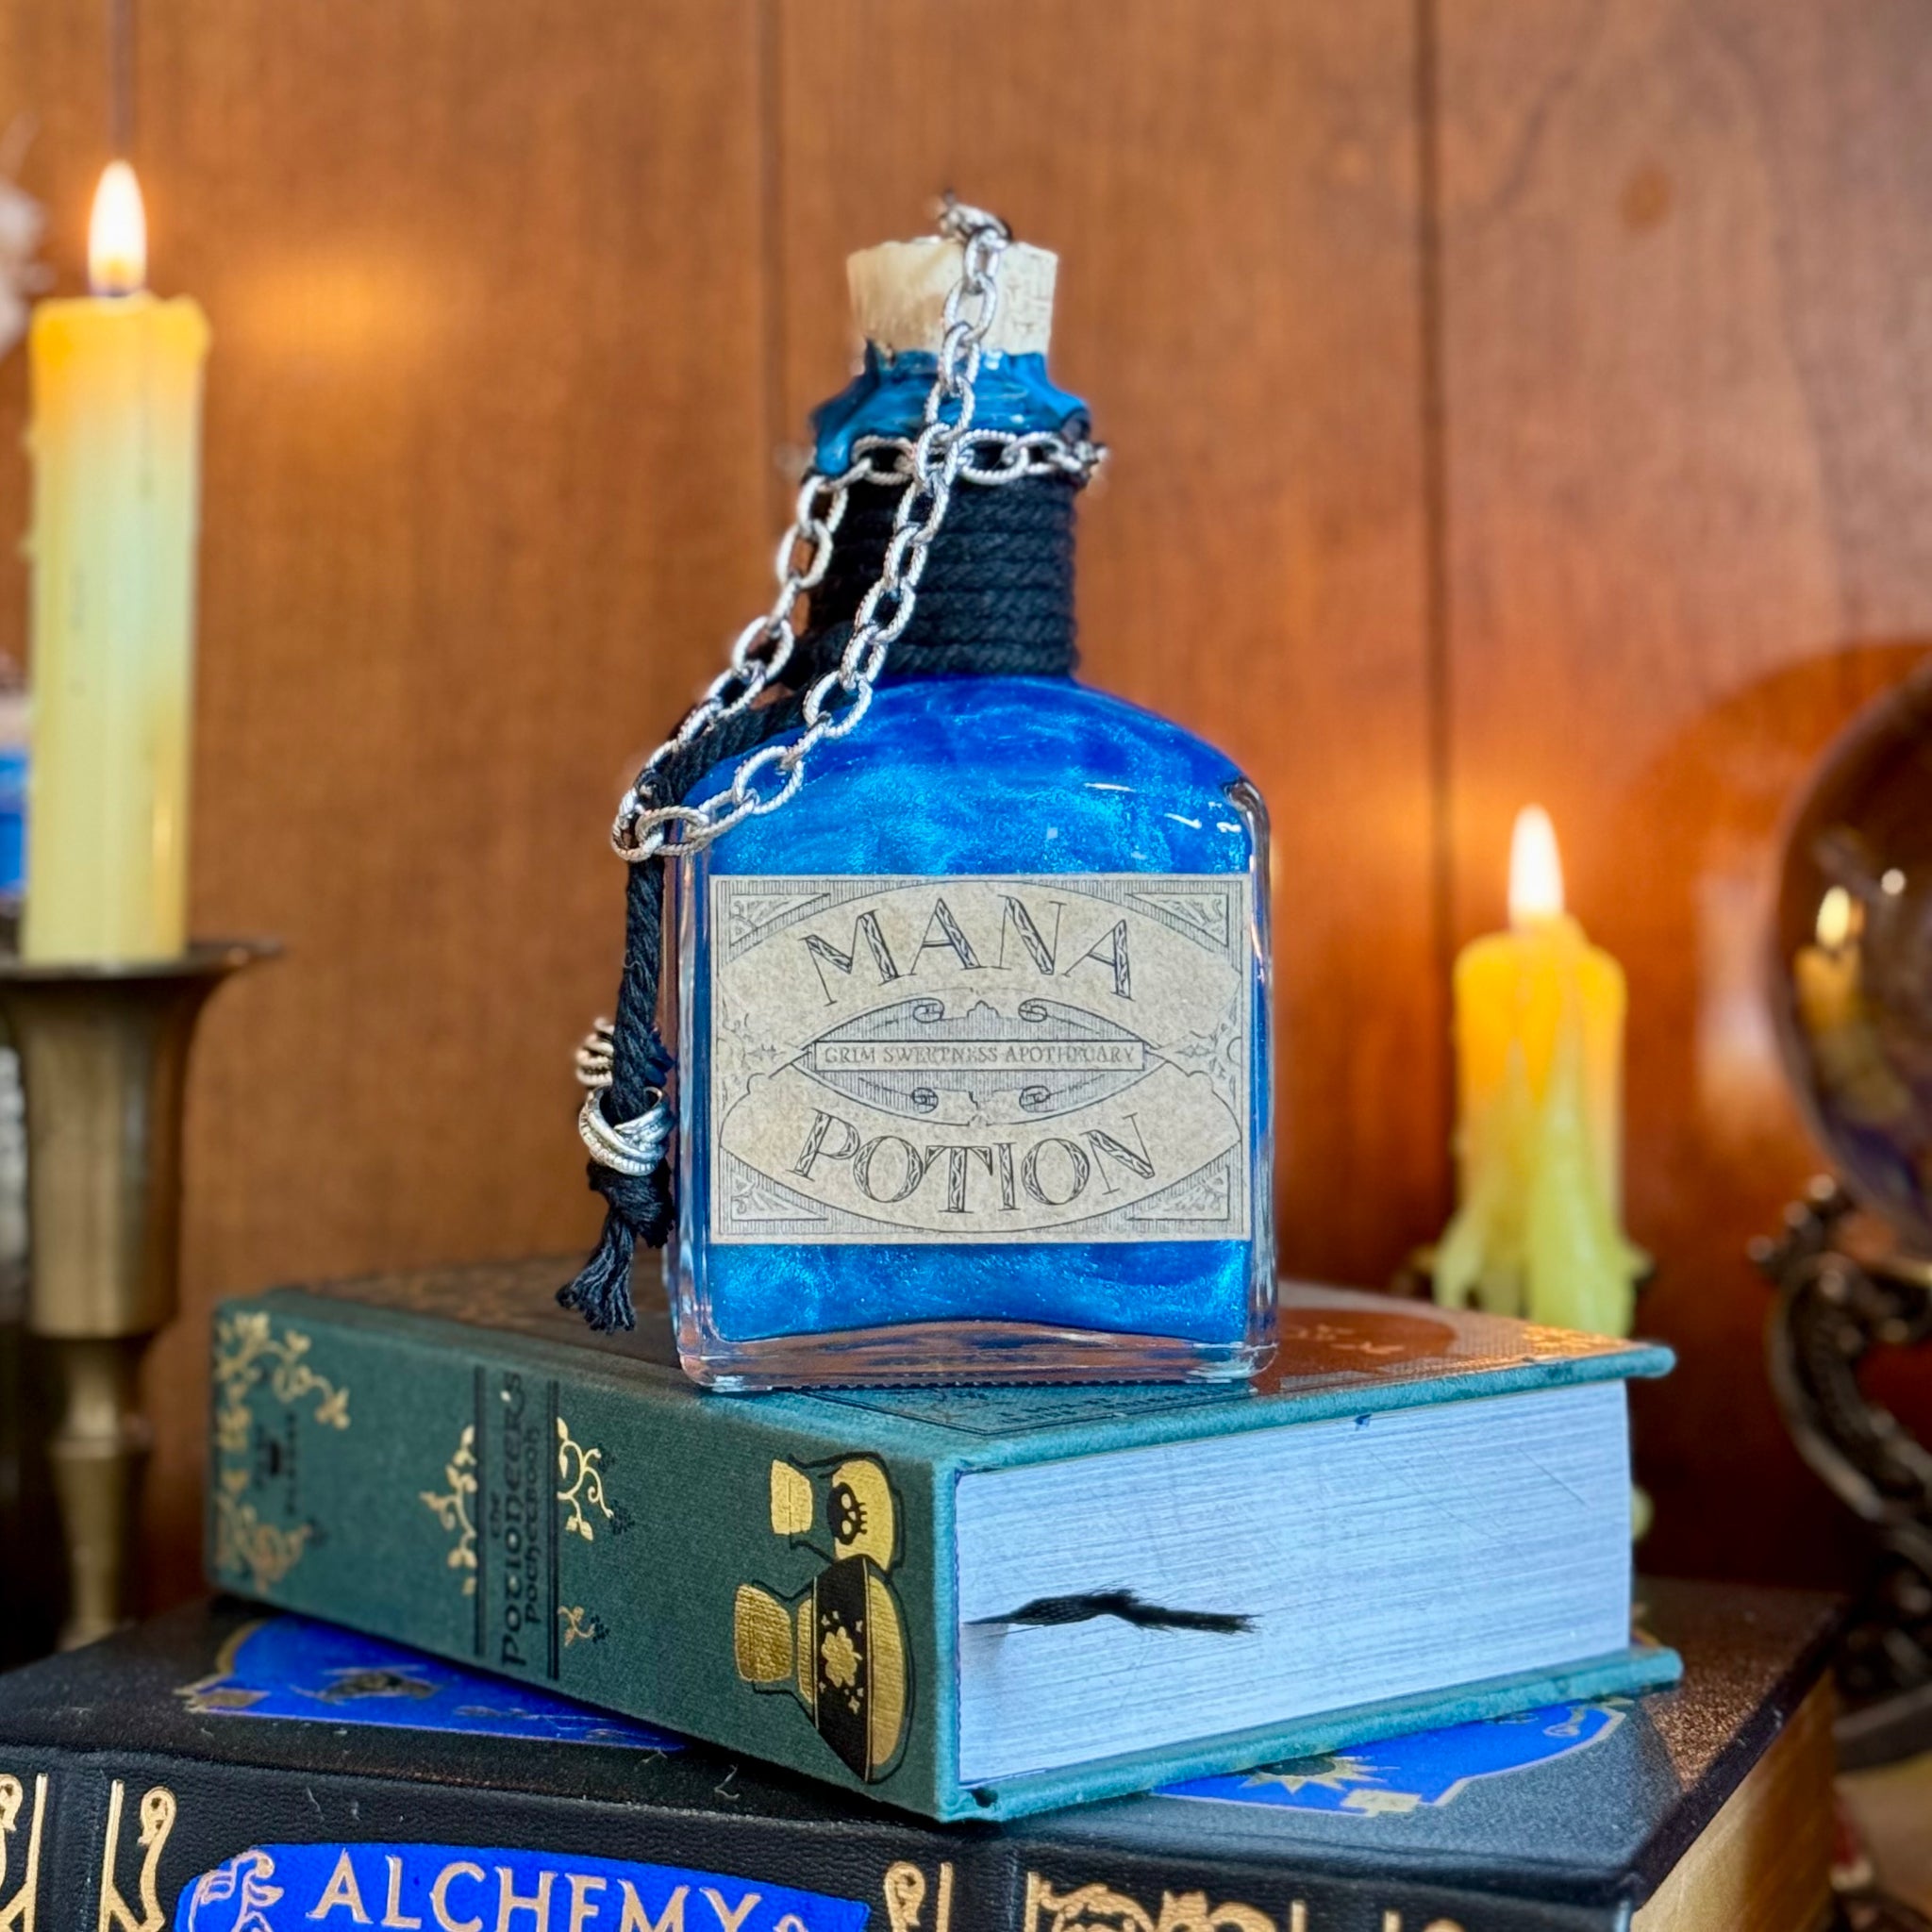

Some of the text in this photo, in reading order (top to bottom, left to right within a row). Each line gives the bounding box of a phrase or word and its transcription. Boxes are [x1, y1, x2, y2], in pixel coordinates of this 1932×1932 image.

[798, 895, 1135, 1007] MANA
[824, 1045, 876, 1064] GRIM
[1005, 1045, 1135, 1064] APOTHECARY
[787, 1108, 1156, 1214] POTION
[305, 1847, 762, 1932] ALCHEMY
